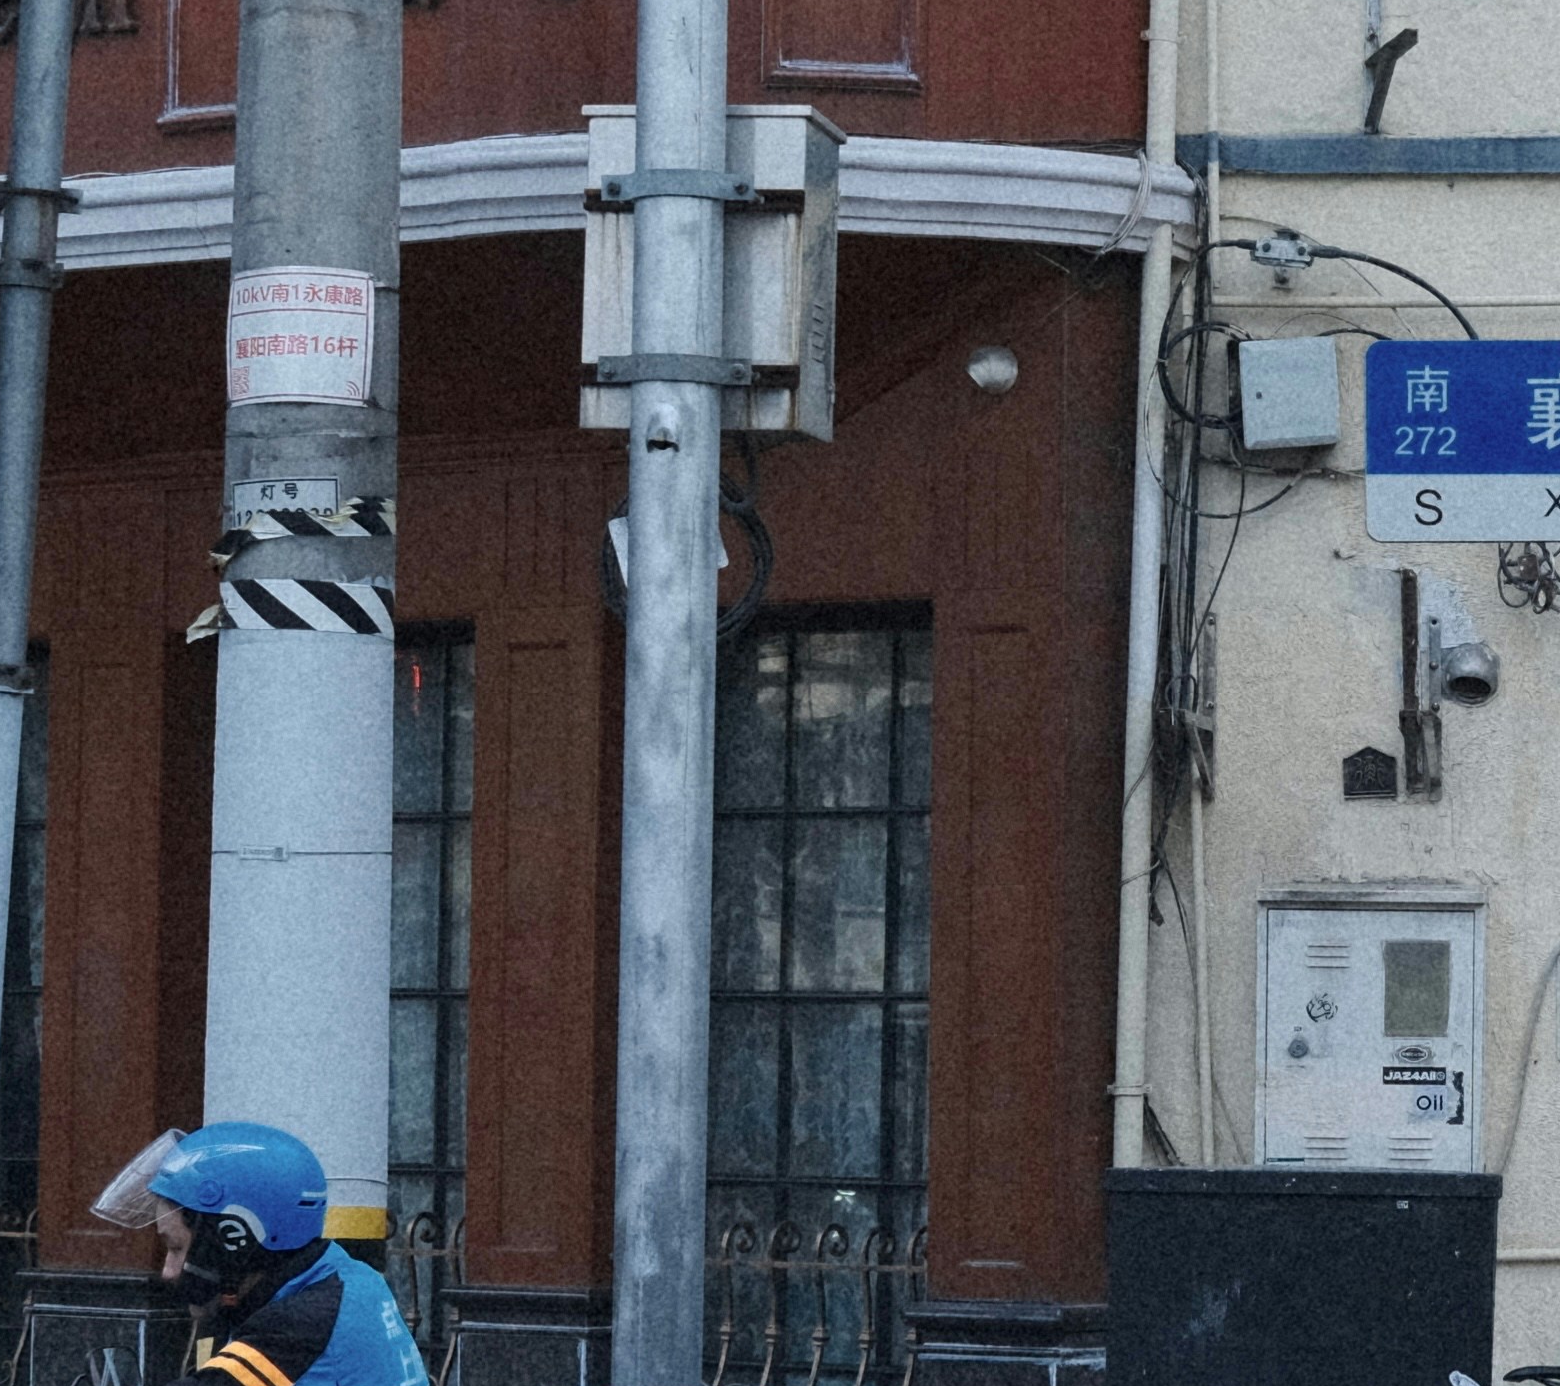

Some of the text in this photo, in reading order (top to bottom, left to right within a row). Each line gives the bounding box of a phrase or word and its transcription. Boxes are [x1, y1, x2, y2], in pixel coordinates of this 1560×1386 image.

[235, 283, 364, 307] 10kV南1永康路
[235, 333, 359, 360] 襄阳南路16杆
[1405, 364, 1450, 416] 南
[1395, 425, 1458, 458] 272
[1412, 488, 1445, 528] S
[1416, 1094, 1444, 1111] Oil
